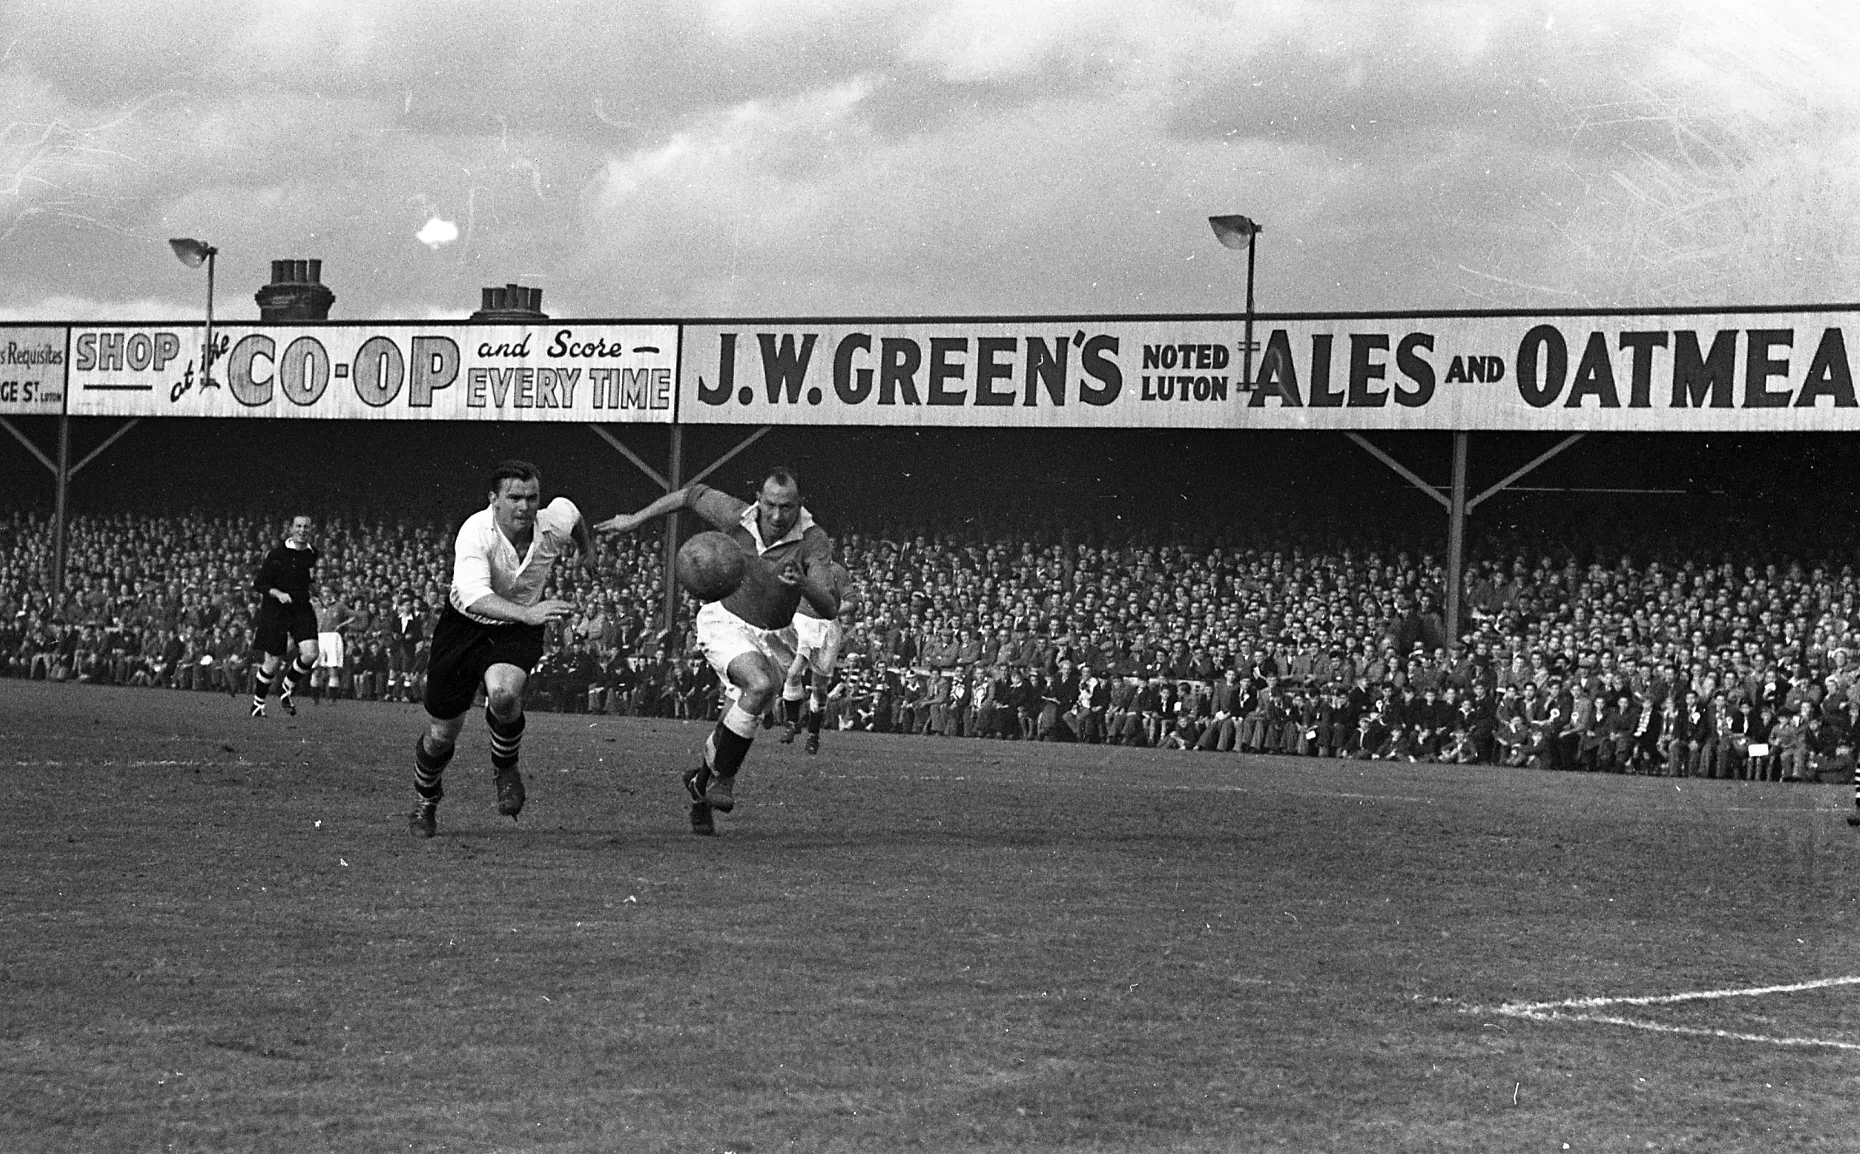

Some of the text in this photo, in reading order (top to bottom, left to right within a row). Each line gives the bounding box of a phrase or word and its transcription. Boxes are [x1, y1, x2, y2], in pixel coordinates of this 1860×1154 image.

[8, 341, 63, 369] Requisites
[76, 332, 180, 371] SHOP
[477, 329, 622, 358] and Score
[1142, 344, 1230, 370] NOTED
[170, 359, 194, 402] at
[227, 333, 461, 407] CO-OP
[833, 330, 1123, 407] GREEN'S
[1247, 323, 1860, 409] ALES AND OATMEA
[466, 367, 672, 410] EVERY TIME
[1141, 375, 1229, 401] LUTON
